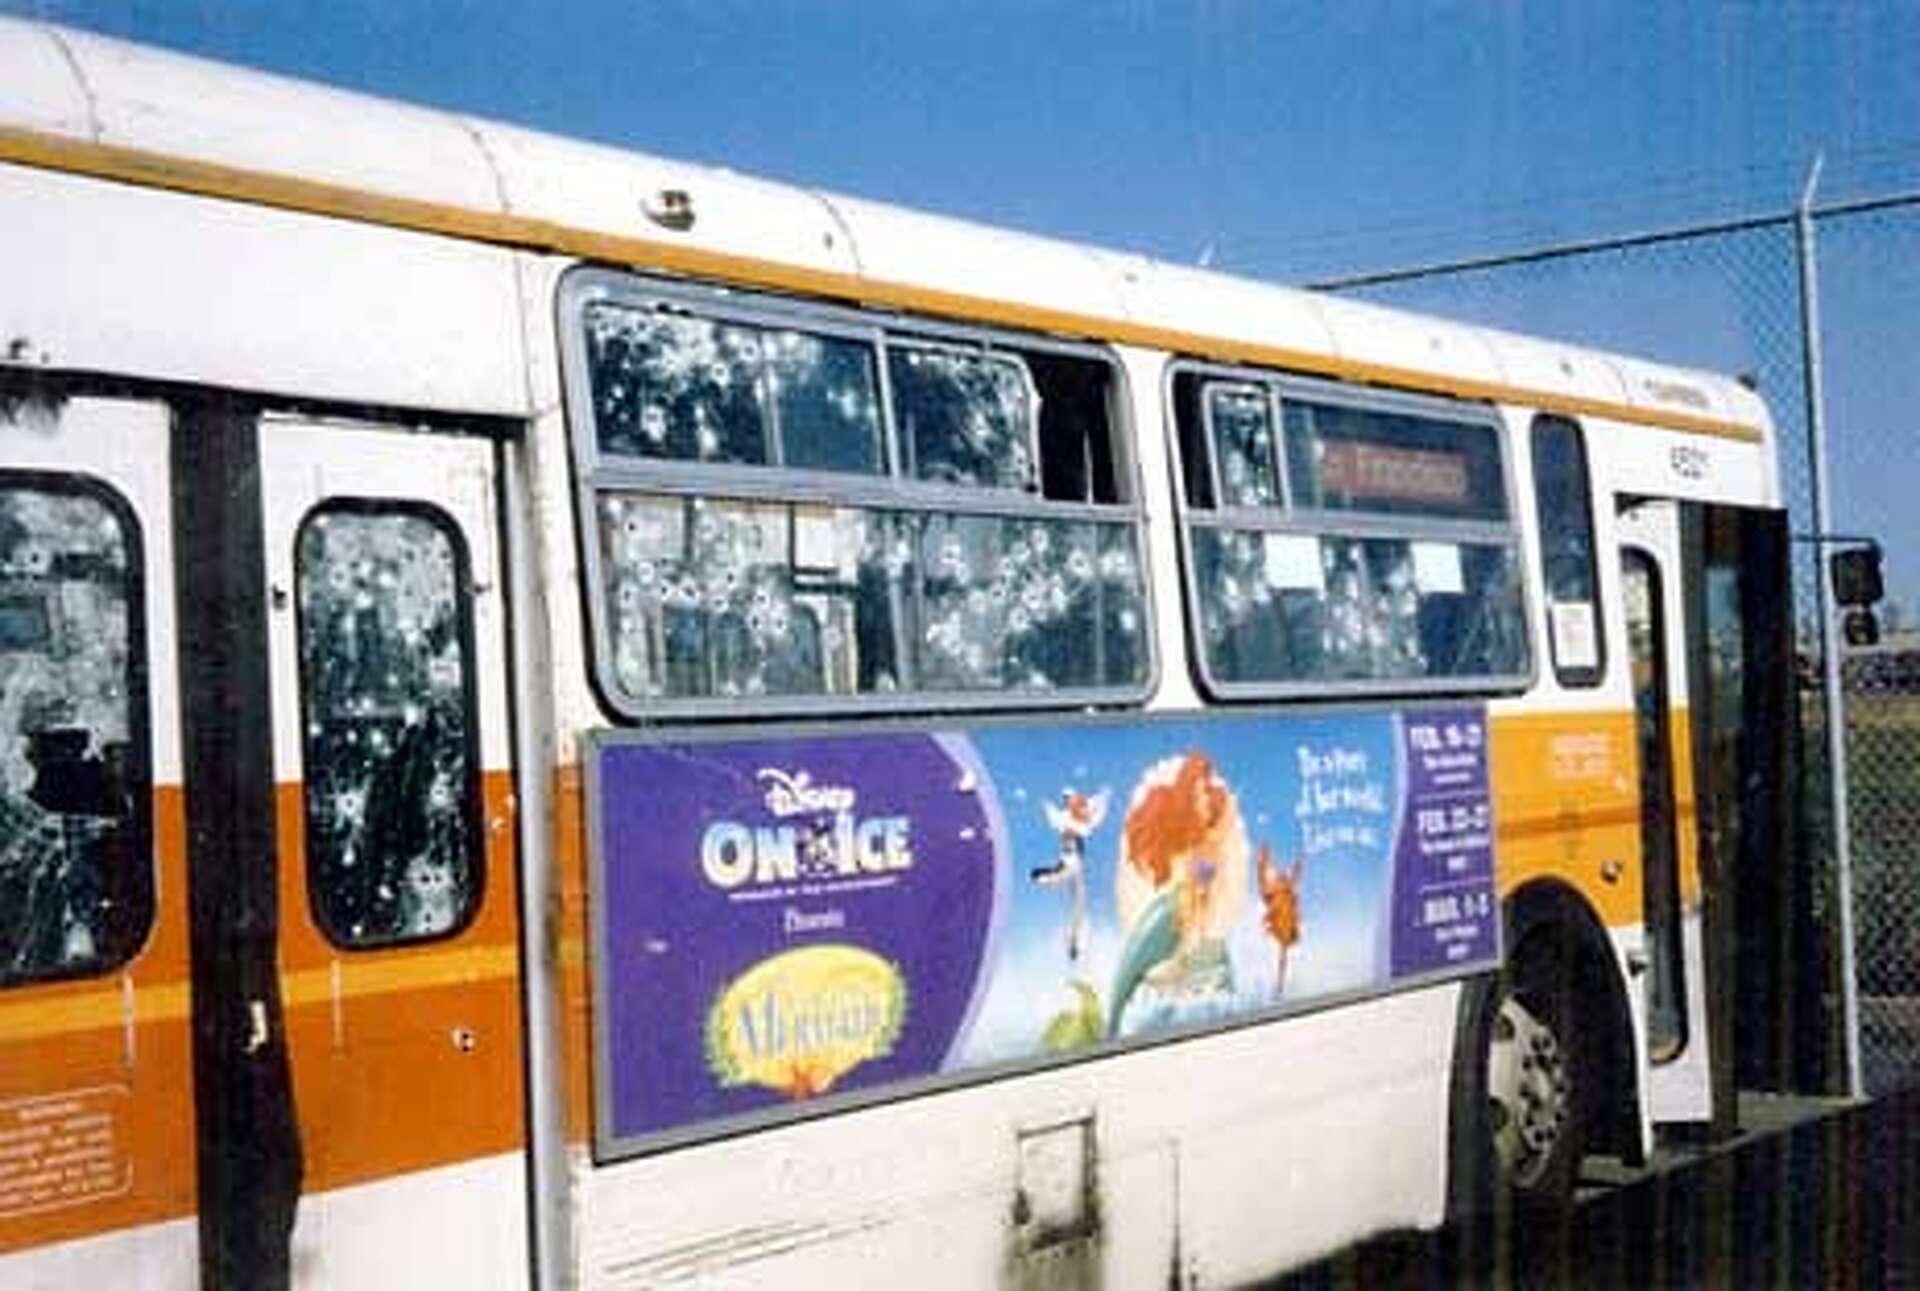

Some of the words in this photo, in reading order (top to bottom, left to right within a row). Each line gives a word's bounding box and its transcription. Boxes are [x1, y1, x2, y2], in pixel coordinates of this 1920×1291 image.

[756, 767, 856, 818] Disney
[702, 822, 798, 888] ON
[835, 812, 913, 875] ICE
